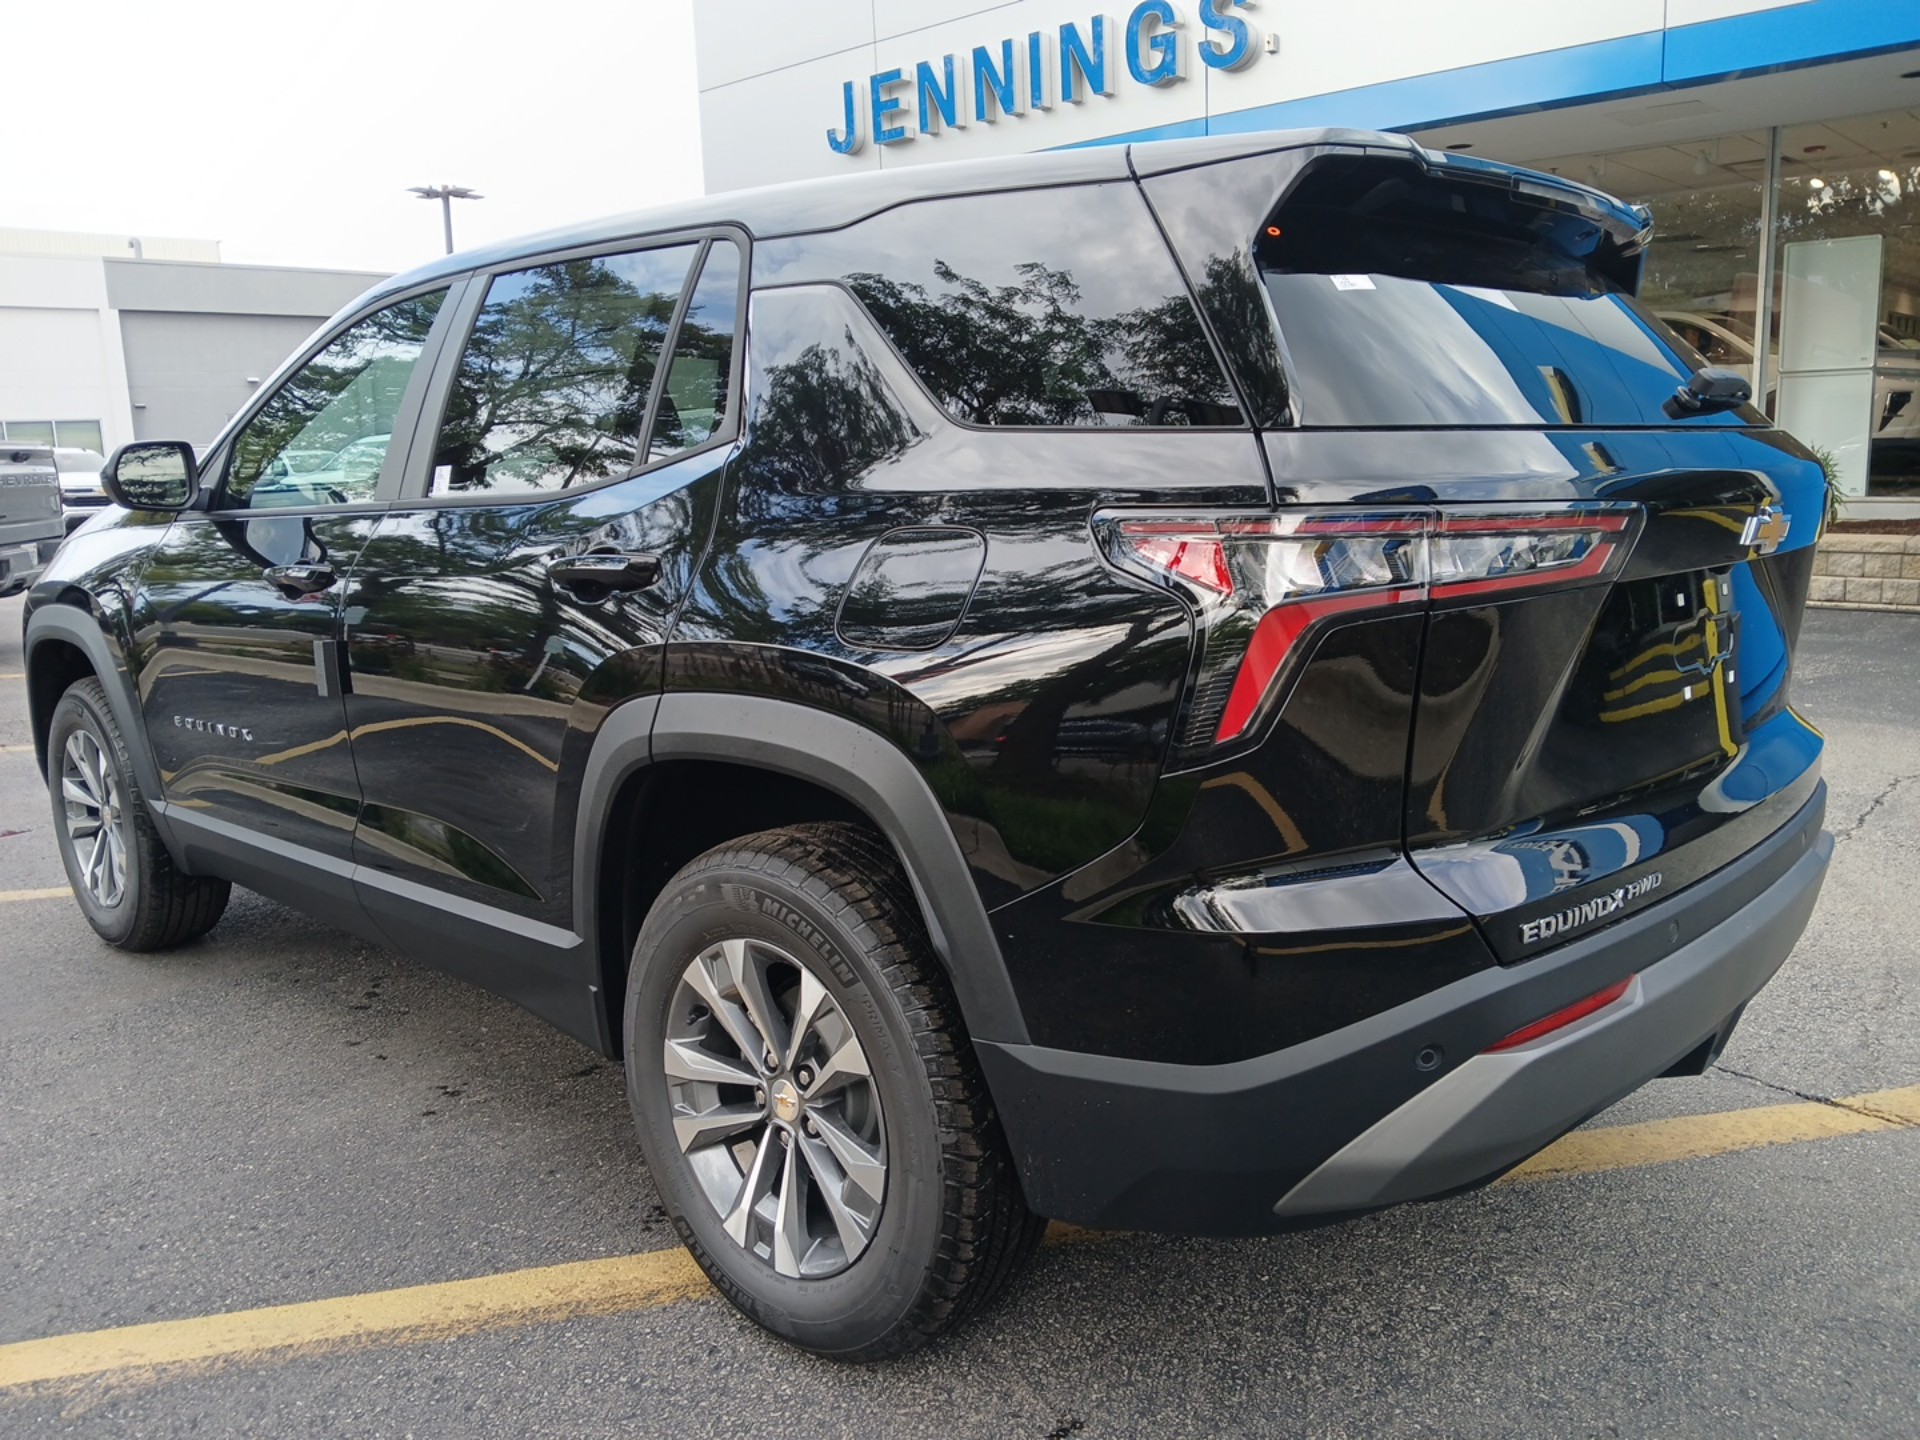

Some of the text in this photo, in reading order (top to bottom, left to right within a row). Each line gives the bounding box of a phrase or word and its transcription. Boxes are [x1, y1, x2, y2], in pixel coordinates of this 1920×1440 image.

[826, 0, 1257, 156] JENNINGS
[174, 715, 253, 741] EQUINOX
[761, 898, 855, 983] MICHELIN
[1520, 871, 1663, 944] EQUINOX AWD
